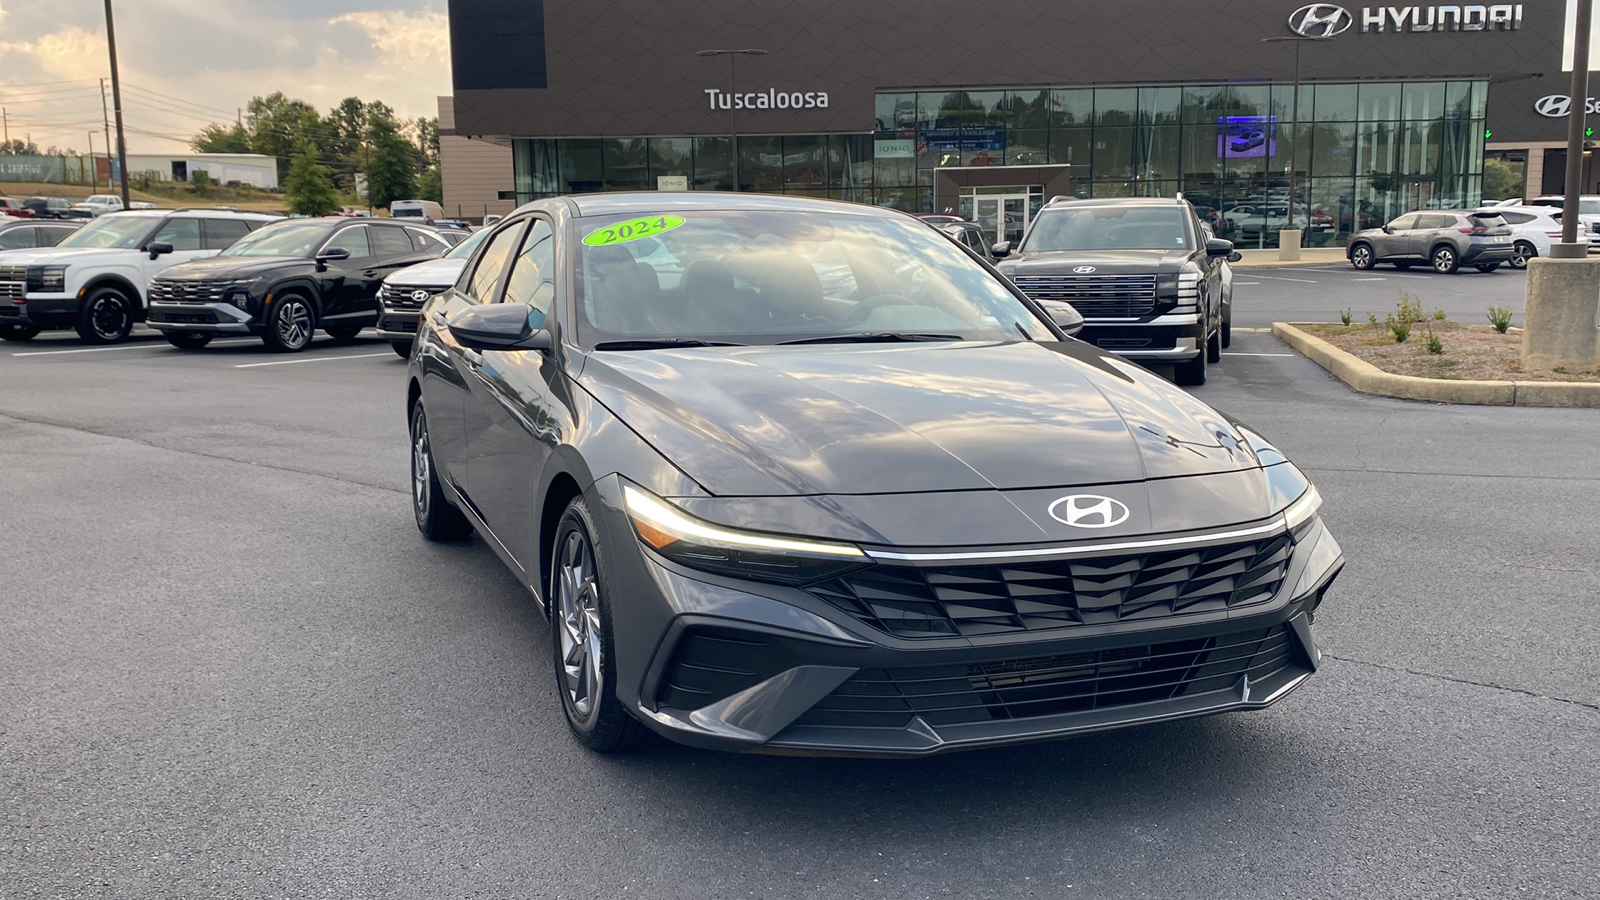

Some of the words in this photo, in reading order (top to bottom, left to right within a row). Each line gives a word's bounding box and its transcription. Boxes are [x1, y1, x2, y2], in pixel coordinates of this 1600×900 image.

[1361, 4, 1523, 33] HYUNDAI
[704, 87, 829, 110] Tuscaloosa
[601, 217, 667, 244] 2024
